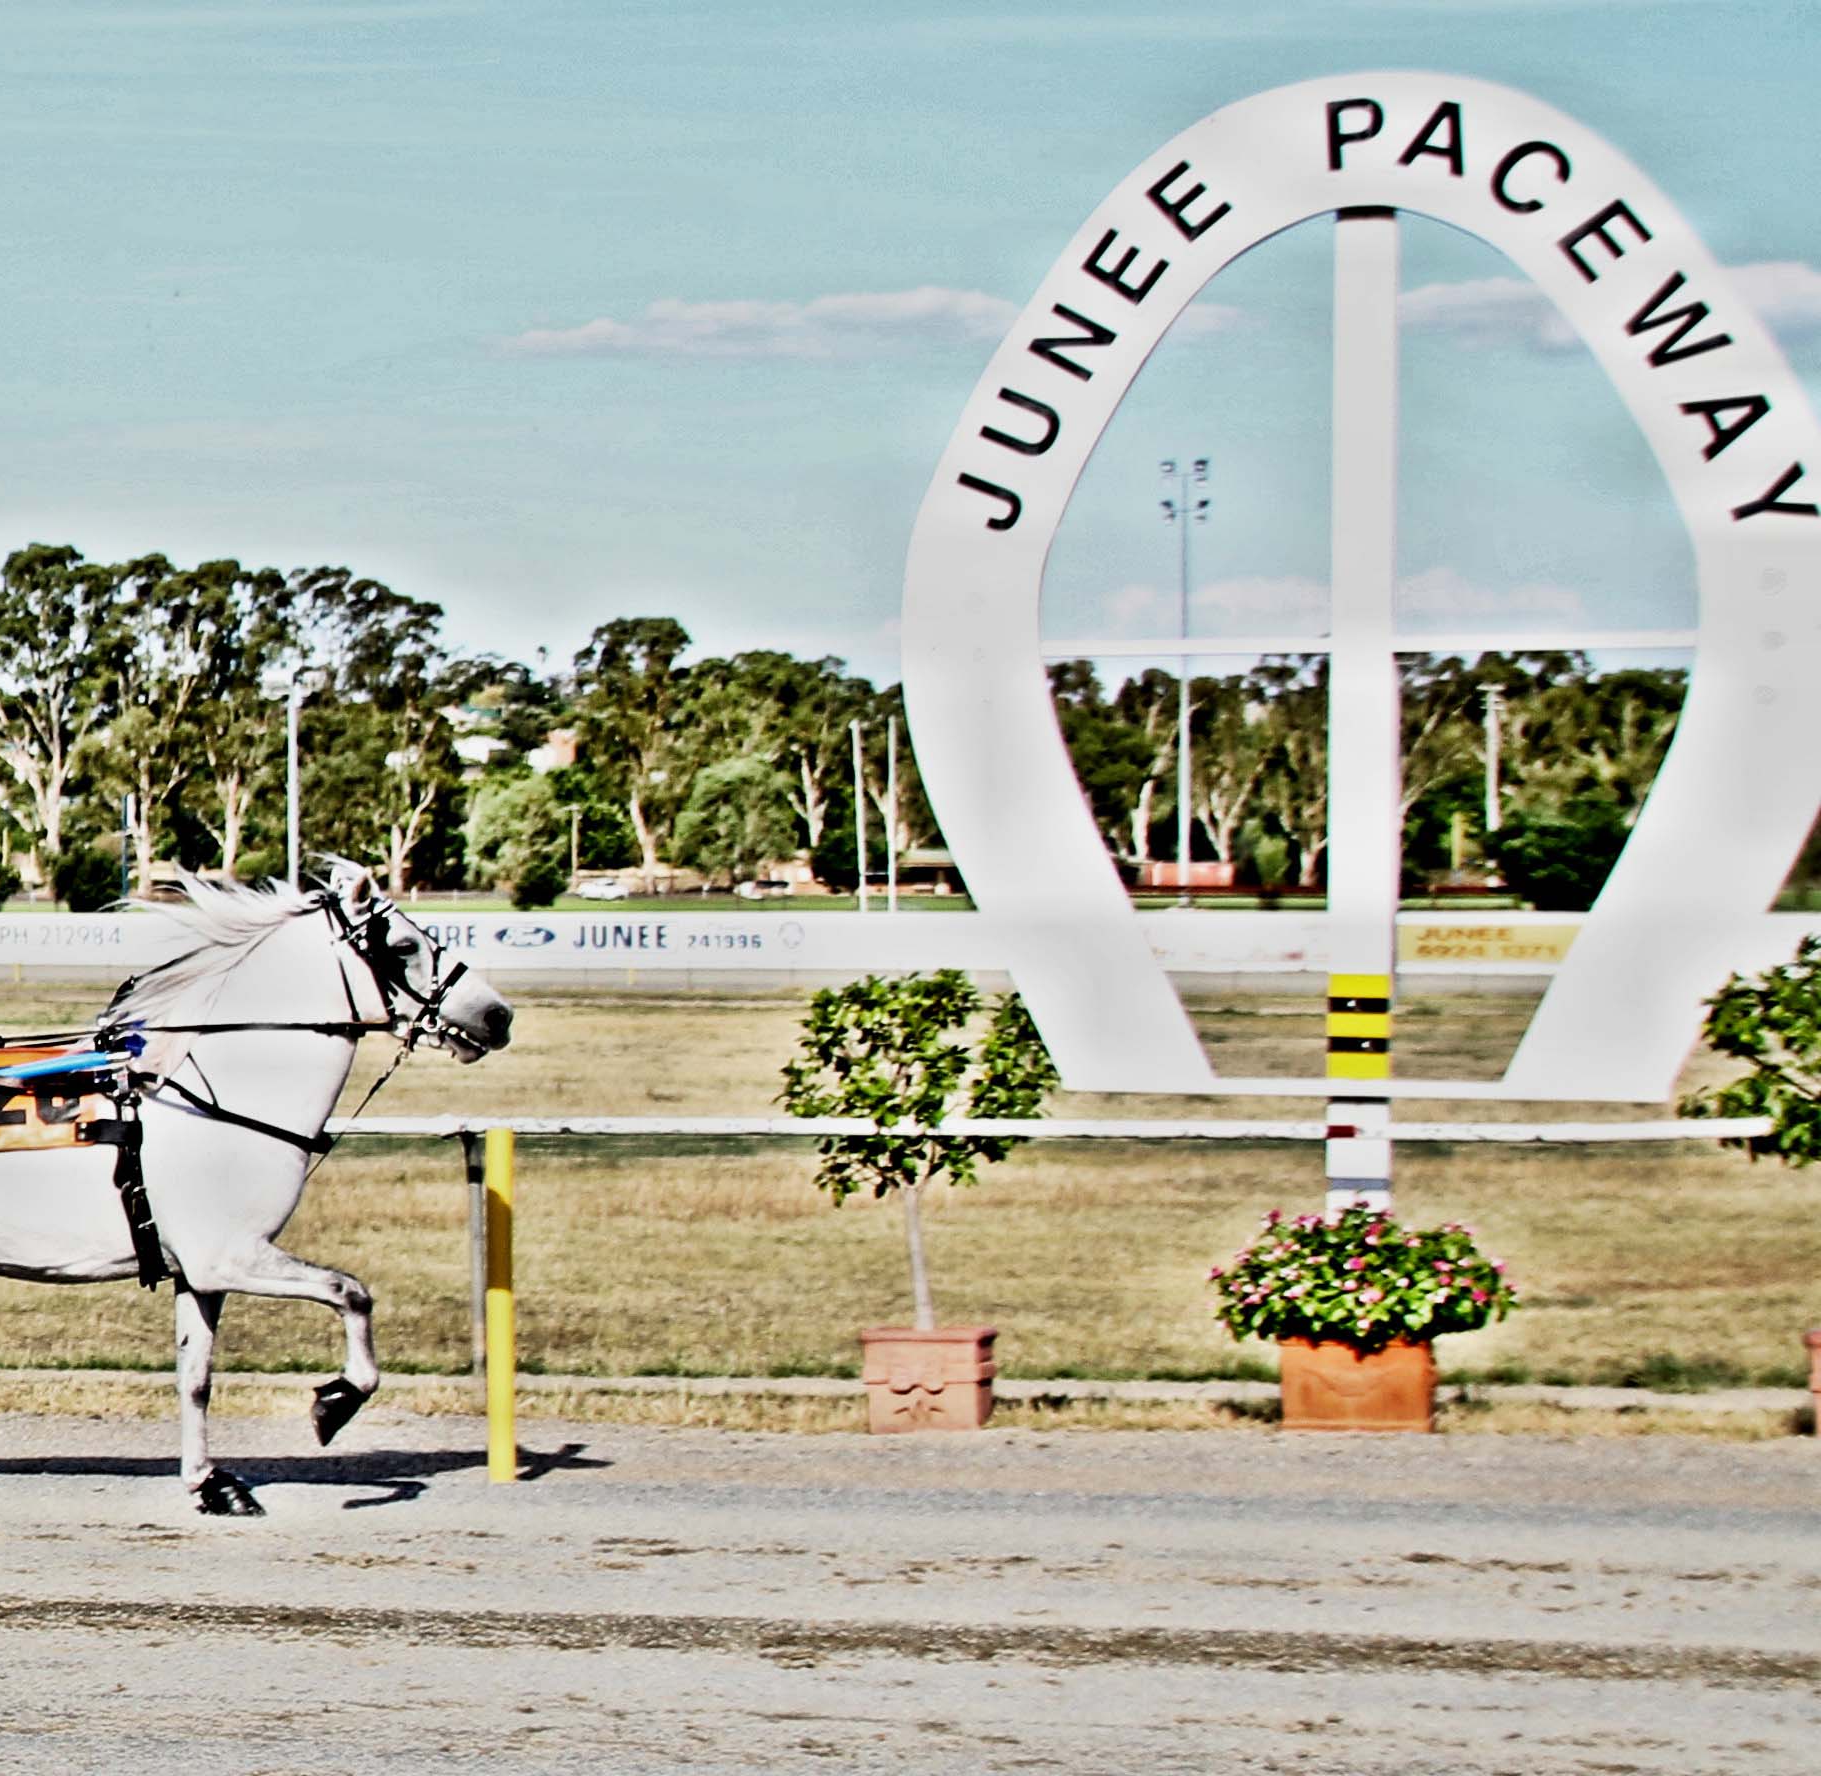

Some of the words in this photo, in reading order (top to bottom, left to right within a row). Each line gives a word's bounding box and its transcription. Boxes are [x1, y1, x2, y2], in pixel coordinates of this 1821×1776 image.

[957, 160, 1233, 532] JUNEE
[1324, 97, 1820, 521] PACEWAY
[0, 925, 28, 945] PH
[573, 924, 668, 949] JUNEE
